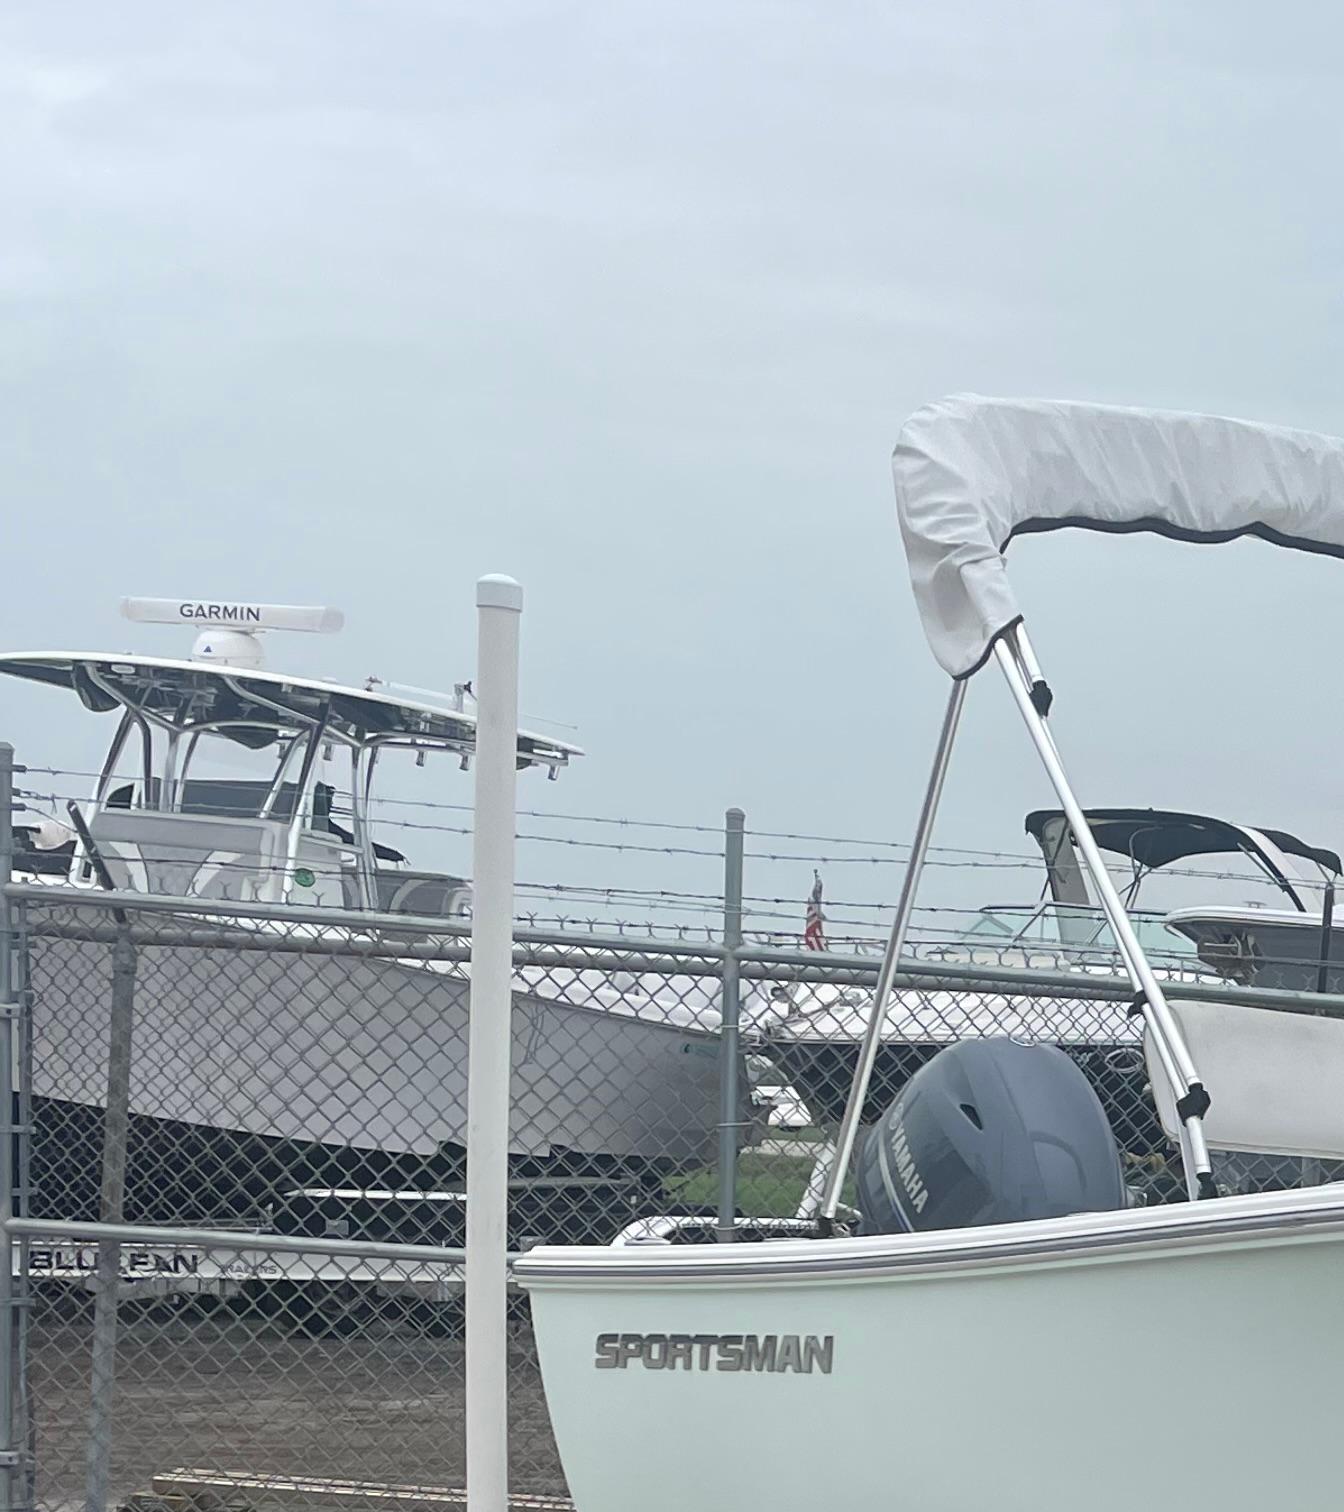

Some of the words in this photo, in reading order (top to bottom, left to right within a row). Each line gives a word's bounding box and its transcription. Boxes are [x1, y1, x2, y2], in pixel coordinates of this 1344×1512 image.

[179, 603, 261, 622] GARMIN
[891, 1120, 929, 1214] YAMAHA
[29, 1250, 121, 1271] BLU
[595, 1333, 834, 1374] SPORTSMAN
